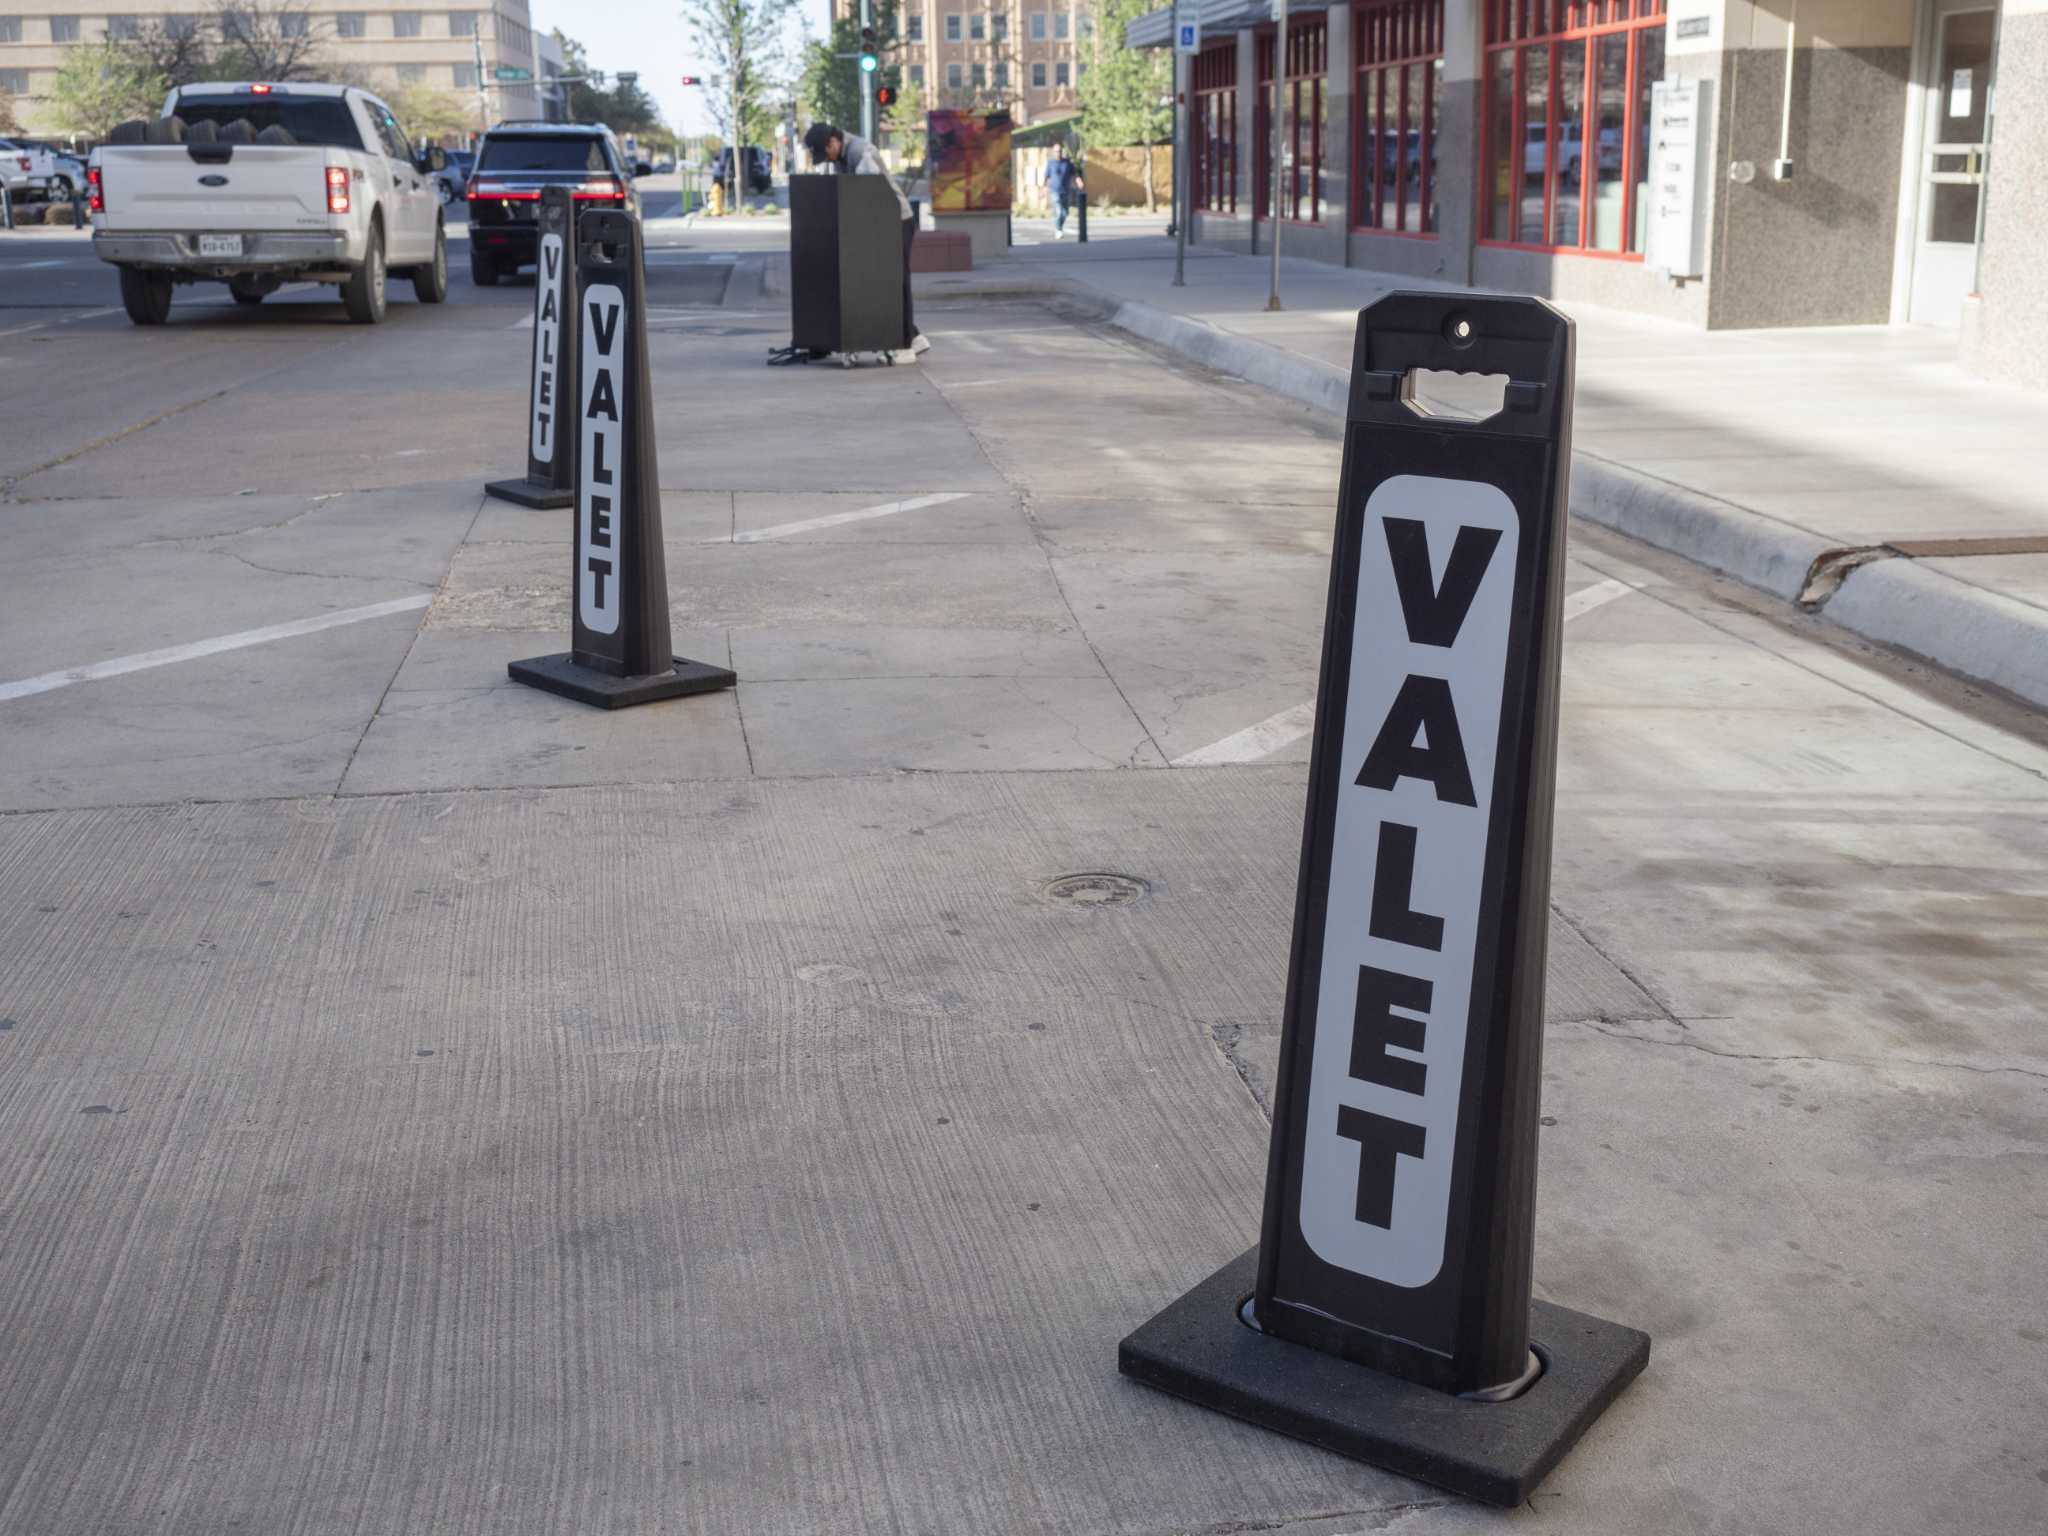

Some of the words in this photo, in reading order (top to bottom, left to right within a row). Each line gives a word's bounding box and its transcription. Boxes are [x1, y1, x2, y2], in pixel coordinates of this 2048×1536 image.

[538, 246, 560, 446] VALET
[587, 303, 619, 609] VALET
[1336, 516, 1504, 1231] VALET
